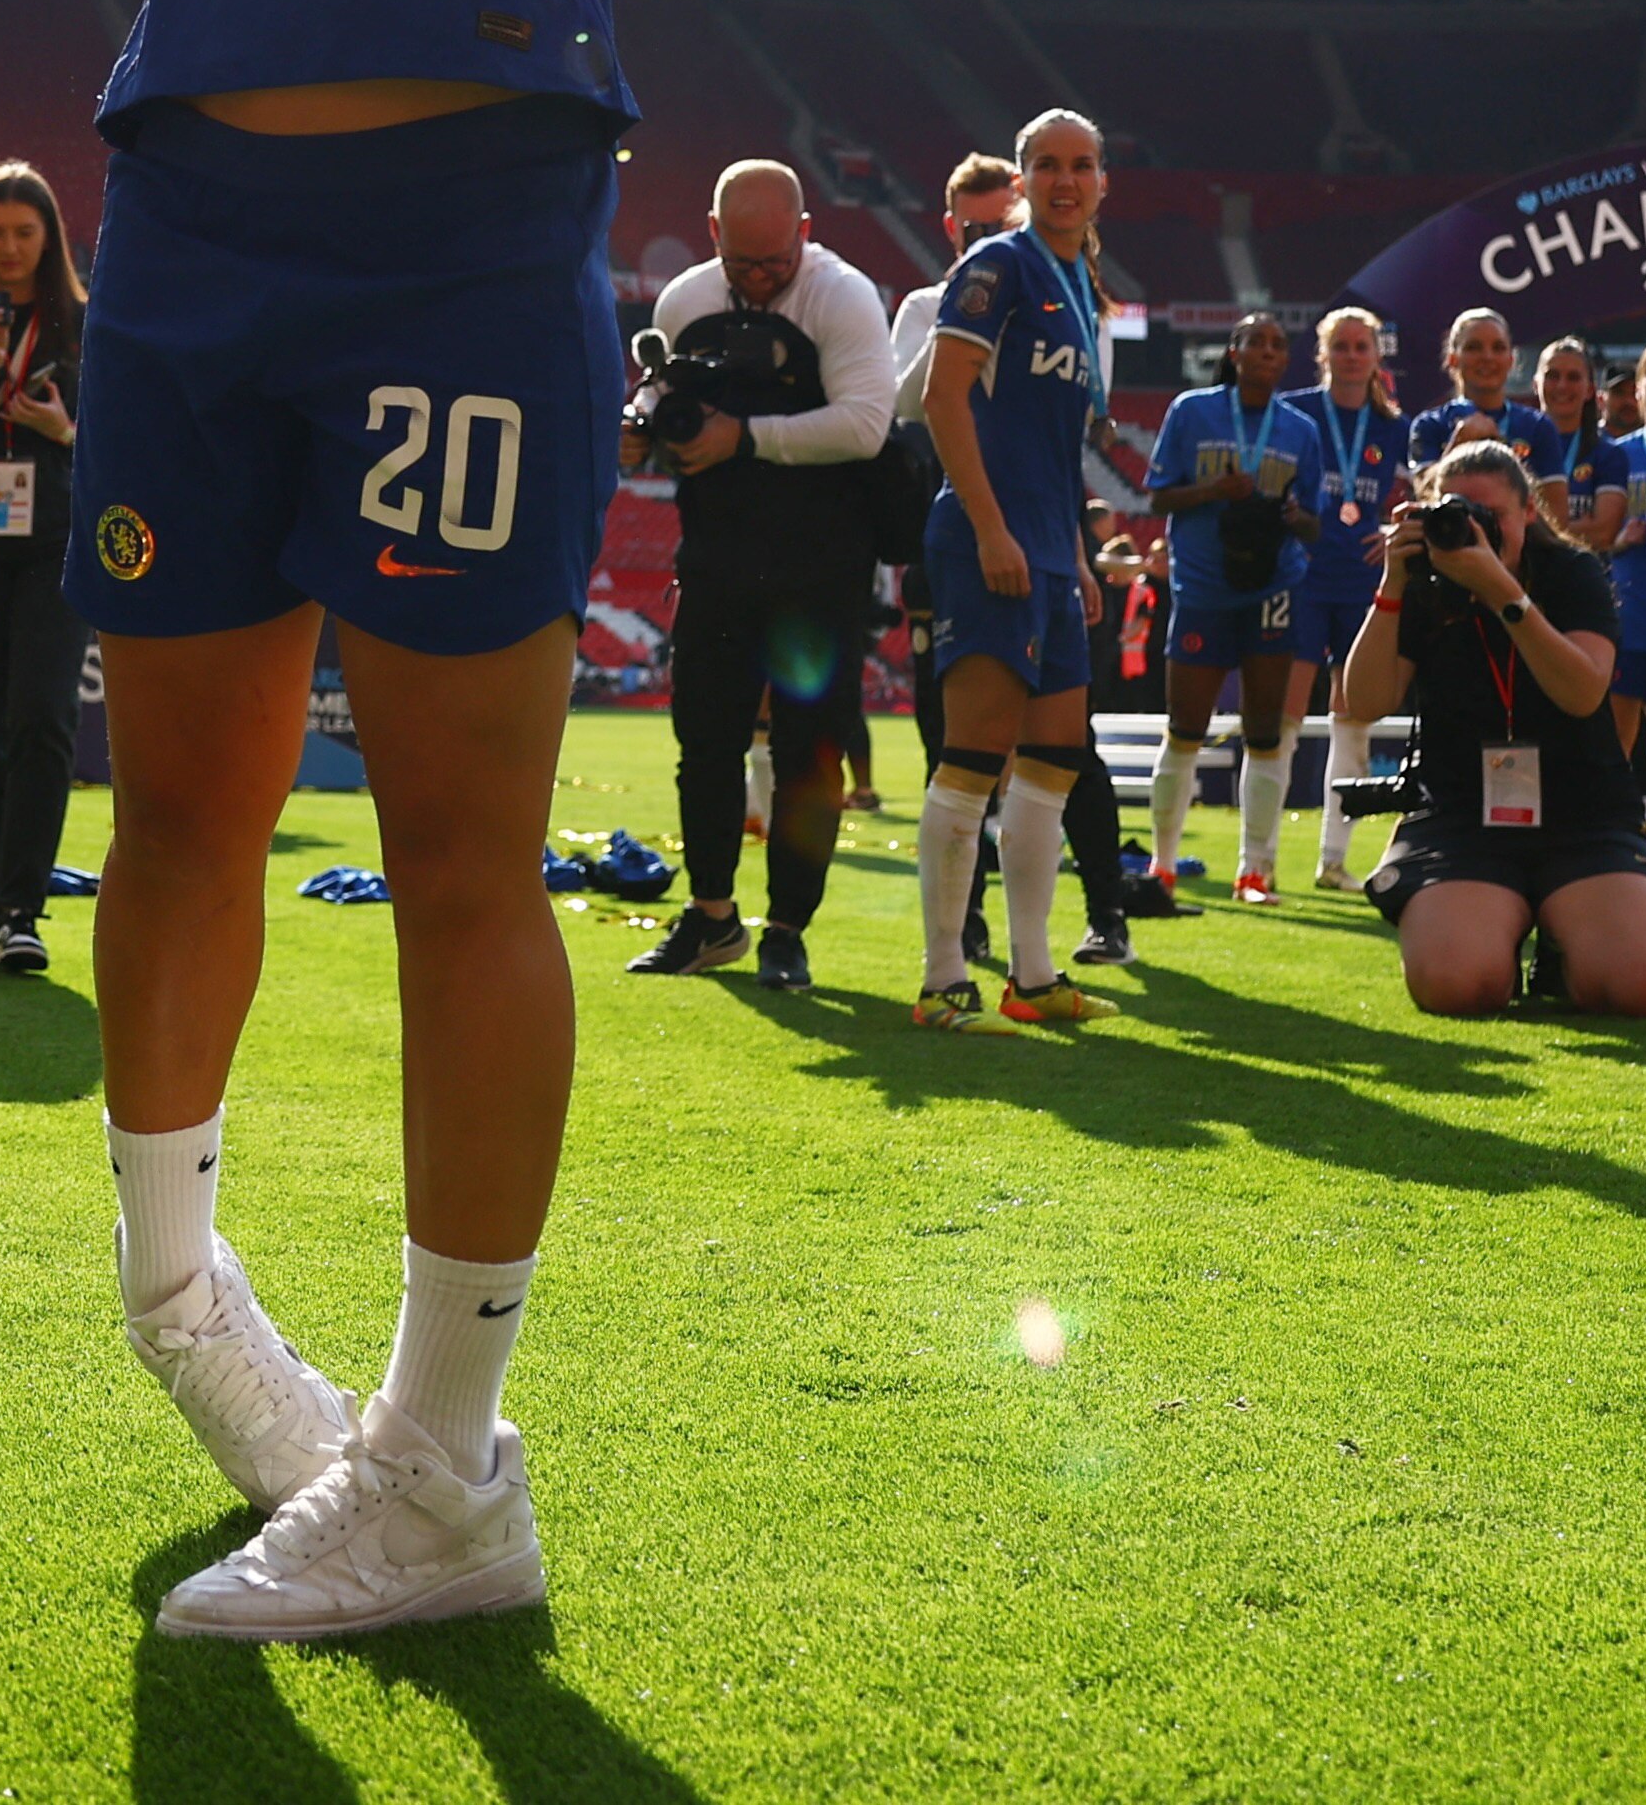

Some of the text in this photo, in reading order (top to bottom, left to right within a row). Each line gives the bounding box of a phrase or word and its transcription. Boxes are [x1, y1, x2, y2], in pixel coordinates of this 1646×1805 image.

[1541, 162, 1637, 206] BARCLAYS
[359, 385, 523, 552] 20
[1261, 590, 1291, 629] 12
